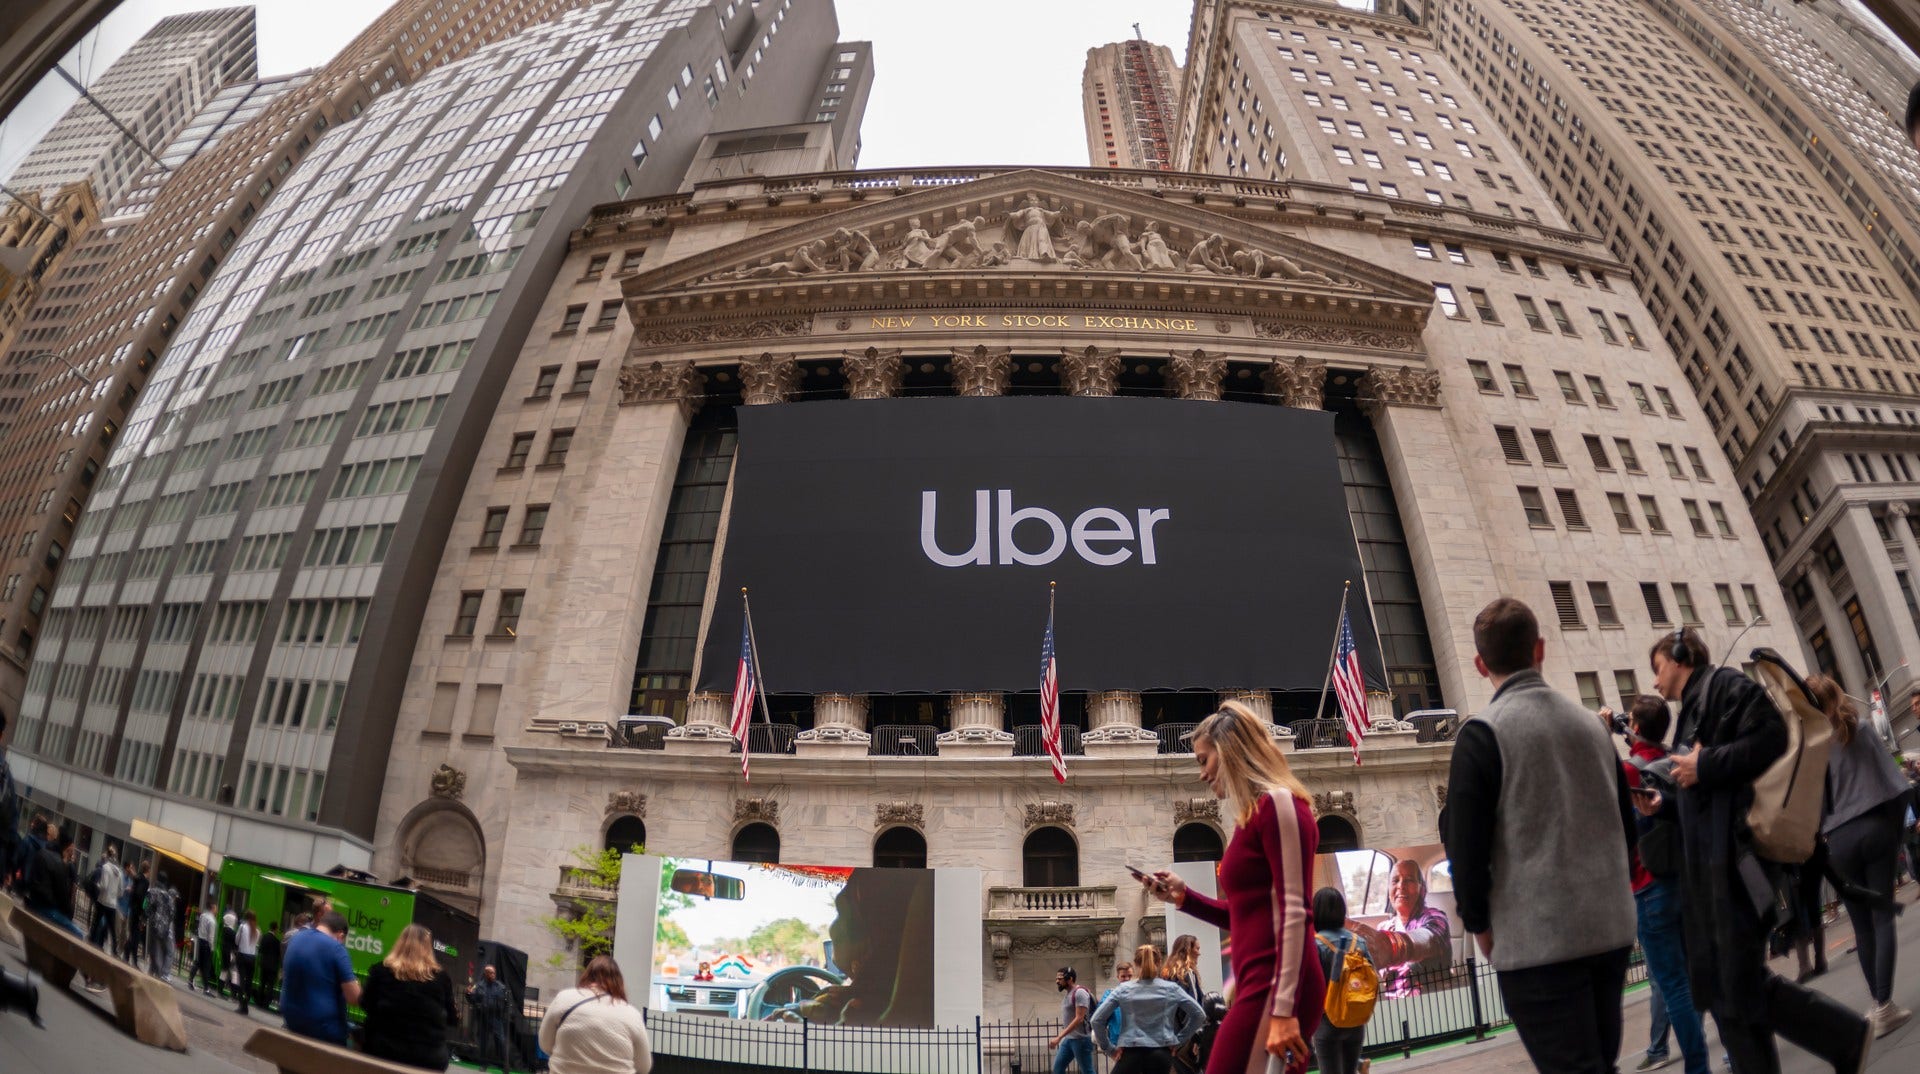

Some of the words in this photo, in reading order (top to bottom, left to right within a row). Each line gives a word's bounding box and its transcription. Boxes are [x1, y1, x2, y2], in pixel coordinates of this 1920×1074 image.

[871, 317, 916, 328] NEW
[931, 315, 989, 327] YORK
[1002, 315, 1070, 327] STOCK
[1084, 316, 1198, 331] EXCHANGE
[921, 489, 1169, 567] Uber
[348, 908, 384, 932] Uber
[345, 930, 382, 955] Eats
